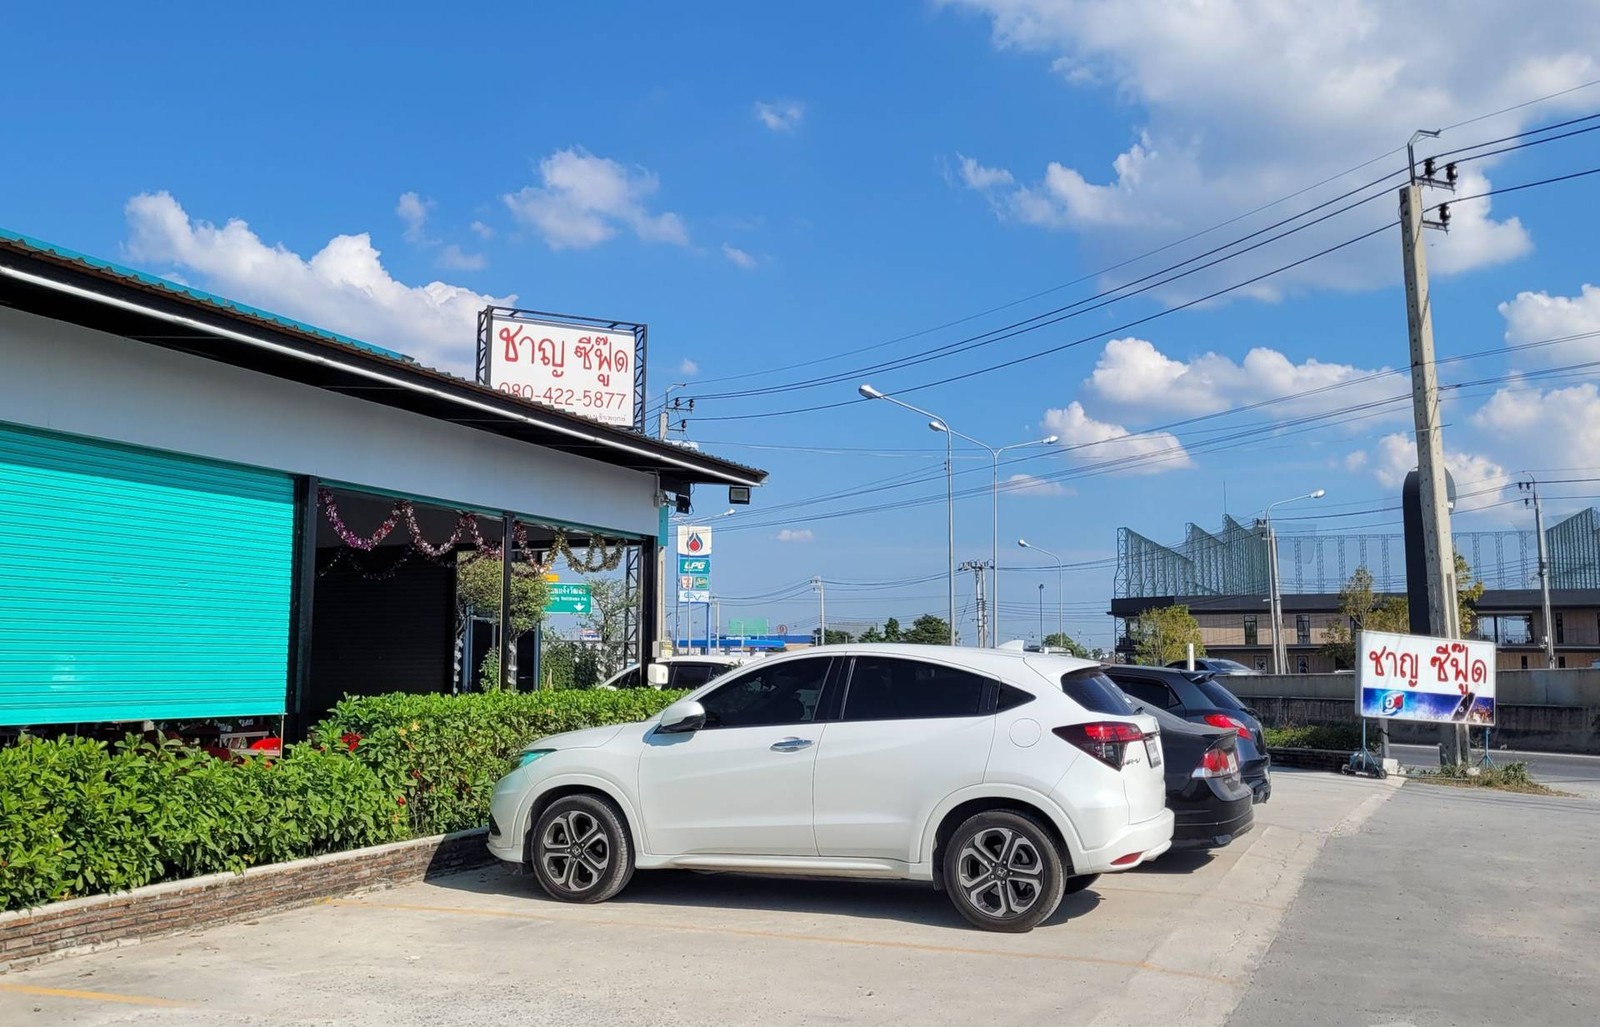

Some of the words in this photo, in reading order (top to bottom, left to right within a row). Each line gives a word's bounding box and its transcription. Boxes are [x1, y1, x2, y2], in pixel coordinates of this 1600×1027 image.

[499, 324, 565, 378] ชาญ
[574, 335, 629, 387] ซีฟู๊ด
[499, 381, 627, 410] 080-422-5877
[684, 561, 706, 569] LPG
[1369, 646, 1419, 687] ชาญ
[1430, 643, 1487, 695] ซีฟู๊ด
